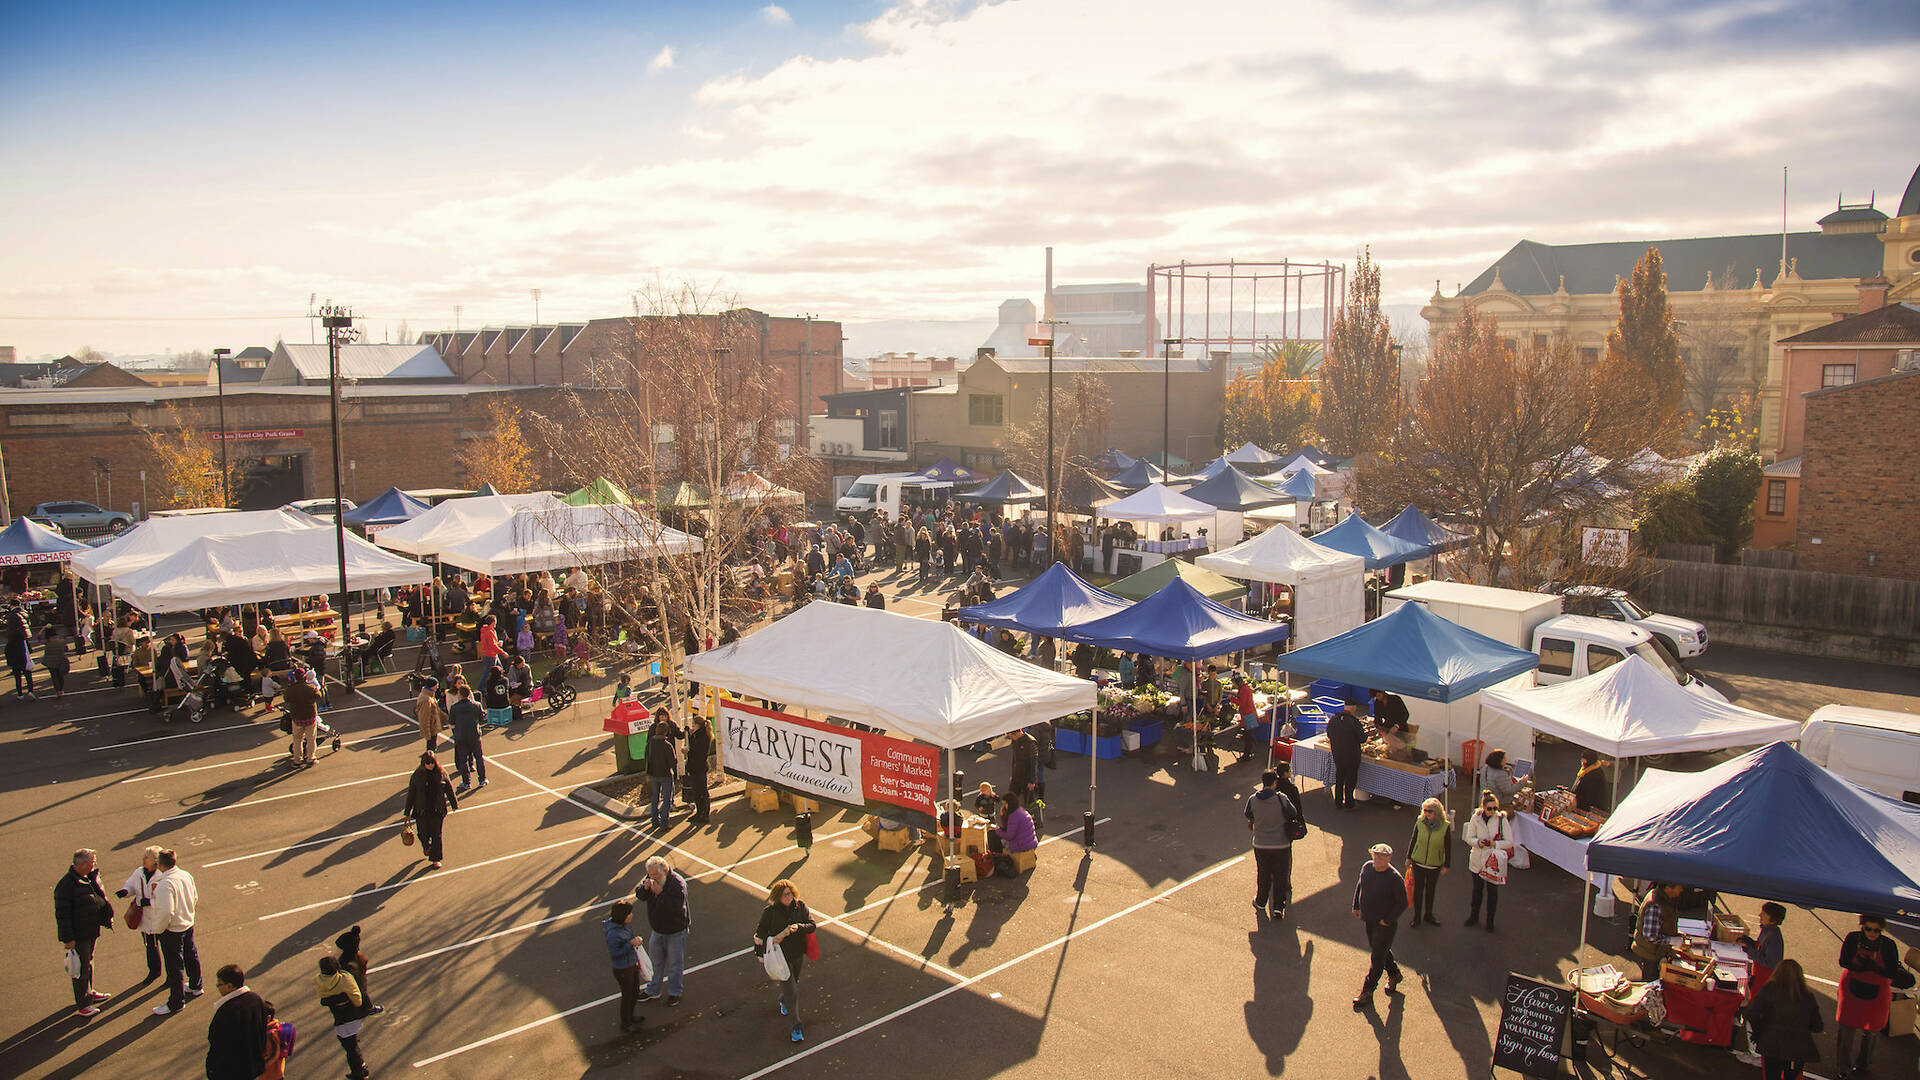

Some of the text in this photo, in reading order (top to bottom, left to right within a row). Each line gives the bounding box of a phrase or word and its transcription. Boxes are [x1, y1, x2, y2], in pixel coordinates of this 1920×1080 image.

[726, 716, 852, 777] HARVEST
[870, 755, 933, 778] Farmers' Market
[886, 747, 932, 768] Community
[774, 761, 853, 795] Launceston
[880, 774, 932, 795] Every Saturday
[872, 783, 899, 797] 8.30am
[1507, 985, 1566, 1014] Harvest
[1539, 991, 1550, 999] THE
[1504, 1013, 1557, 1034] relies on
[1511, 1005, 1554, 1022] COMMUNITY
[1504, 1022, 1555, 1042] VOLUNTEERS
[1499, 1034, 1523, 1054] Sign
[1524, 1045, 1537, 1066] up
